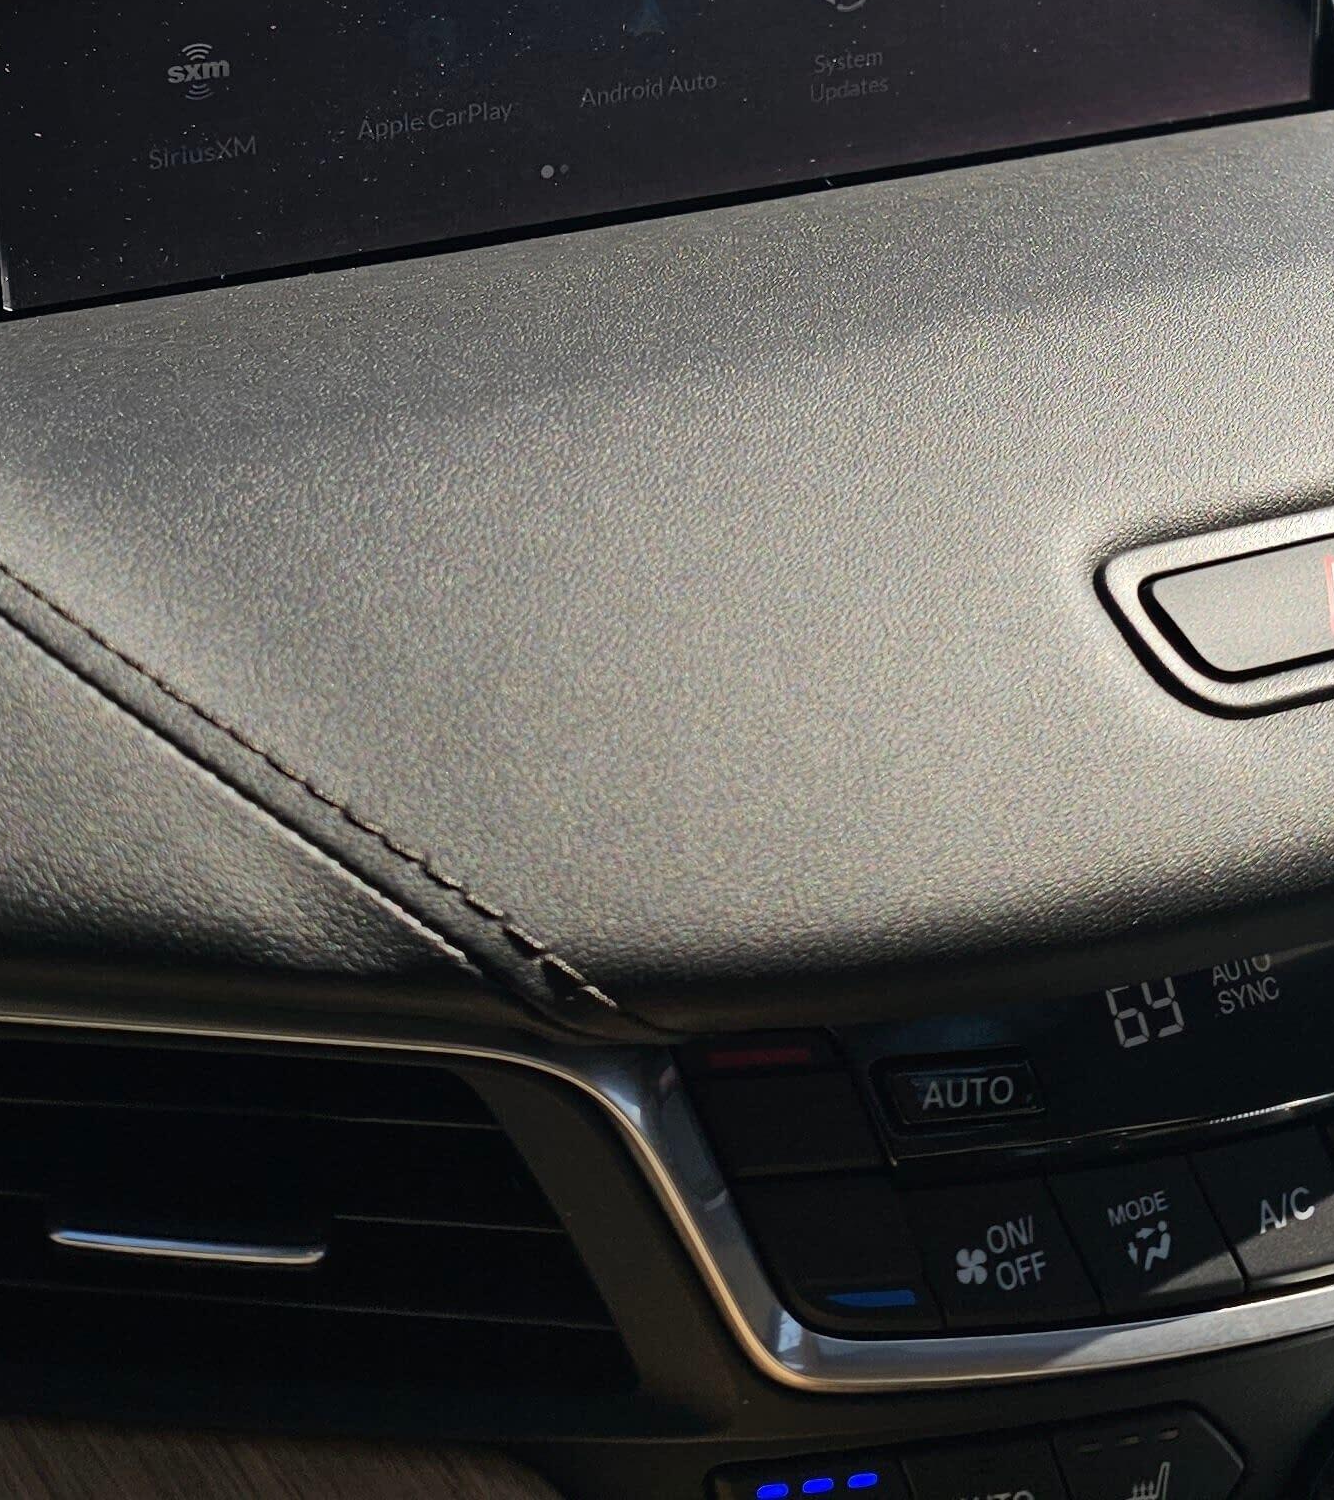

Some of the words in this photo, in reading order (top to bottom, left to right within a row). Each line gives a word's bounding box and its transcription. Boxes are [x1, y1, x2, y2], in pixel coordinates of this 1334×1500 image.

[167, 59, 230, 84] sxm
[814, 50, 884, 77] System
[579, 77, 663, 108] Android
[669, 73, 717, 95] Auto
[810, 78, 889, 107] Updates
[356, 112, 425, 142] Apple
[427, 101, 513, 130] CarPlay
[148, 134, 258, 170] SiriusXM
[1105, 976, 1185, 1048] 69
[1217, 976, 1280, 1015] SYNC
[922, 1075, 1014, 1111] AUTO
[1106, 1189, 1169, 1228] MODE
[1259, 1186, 1316, 1236] A/C
[985, 1214, 1035, 1253] ON/
[995, 1250, 1048, 1292] OFF
